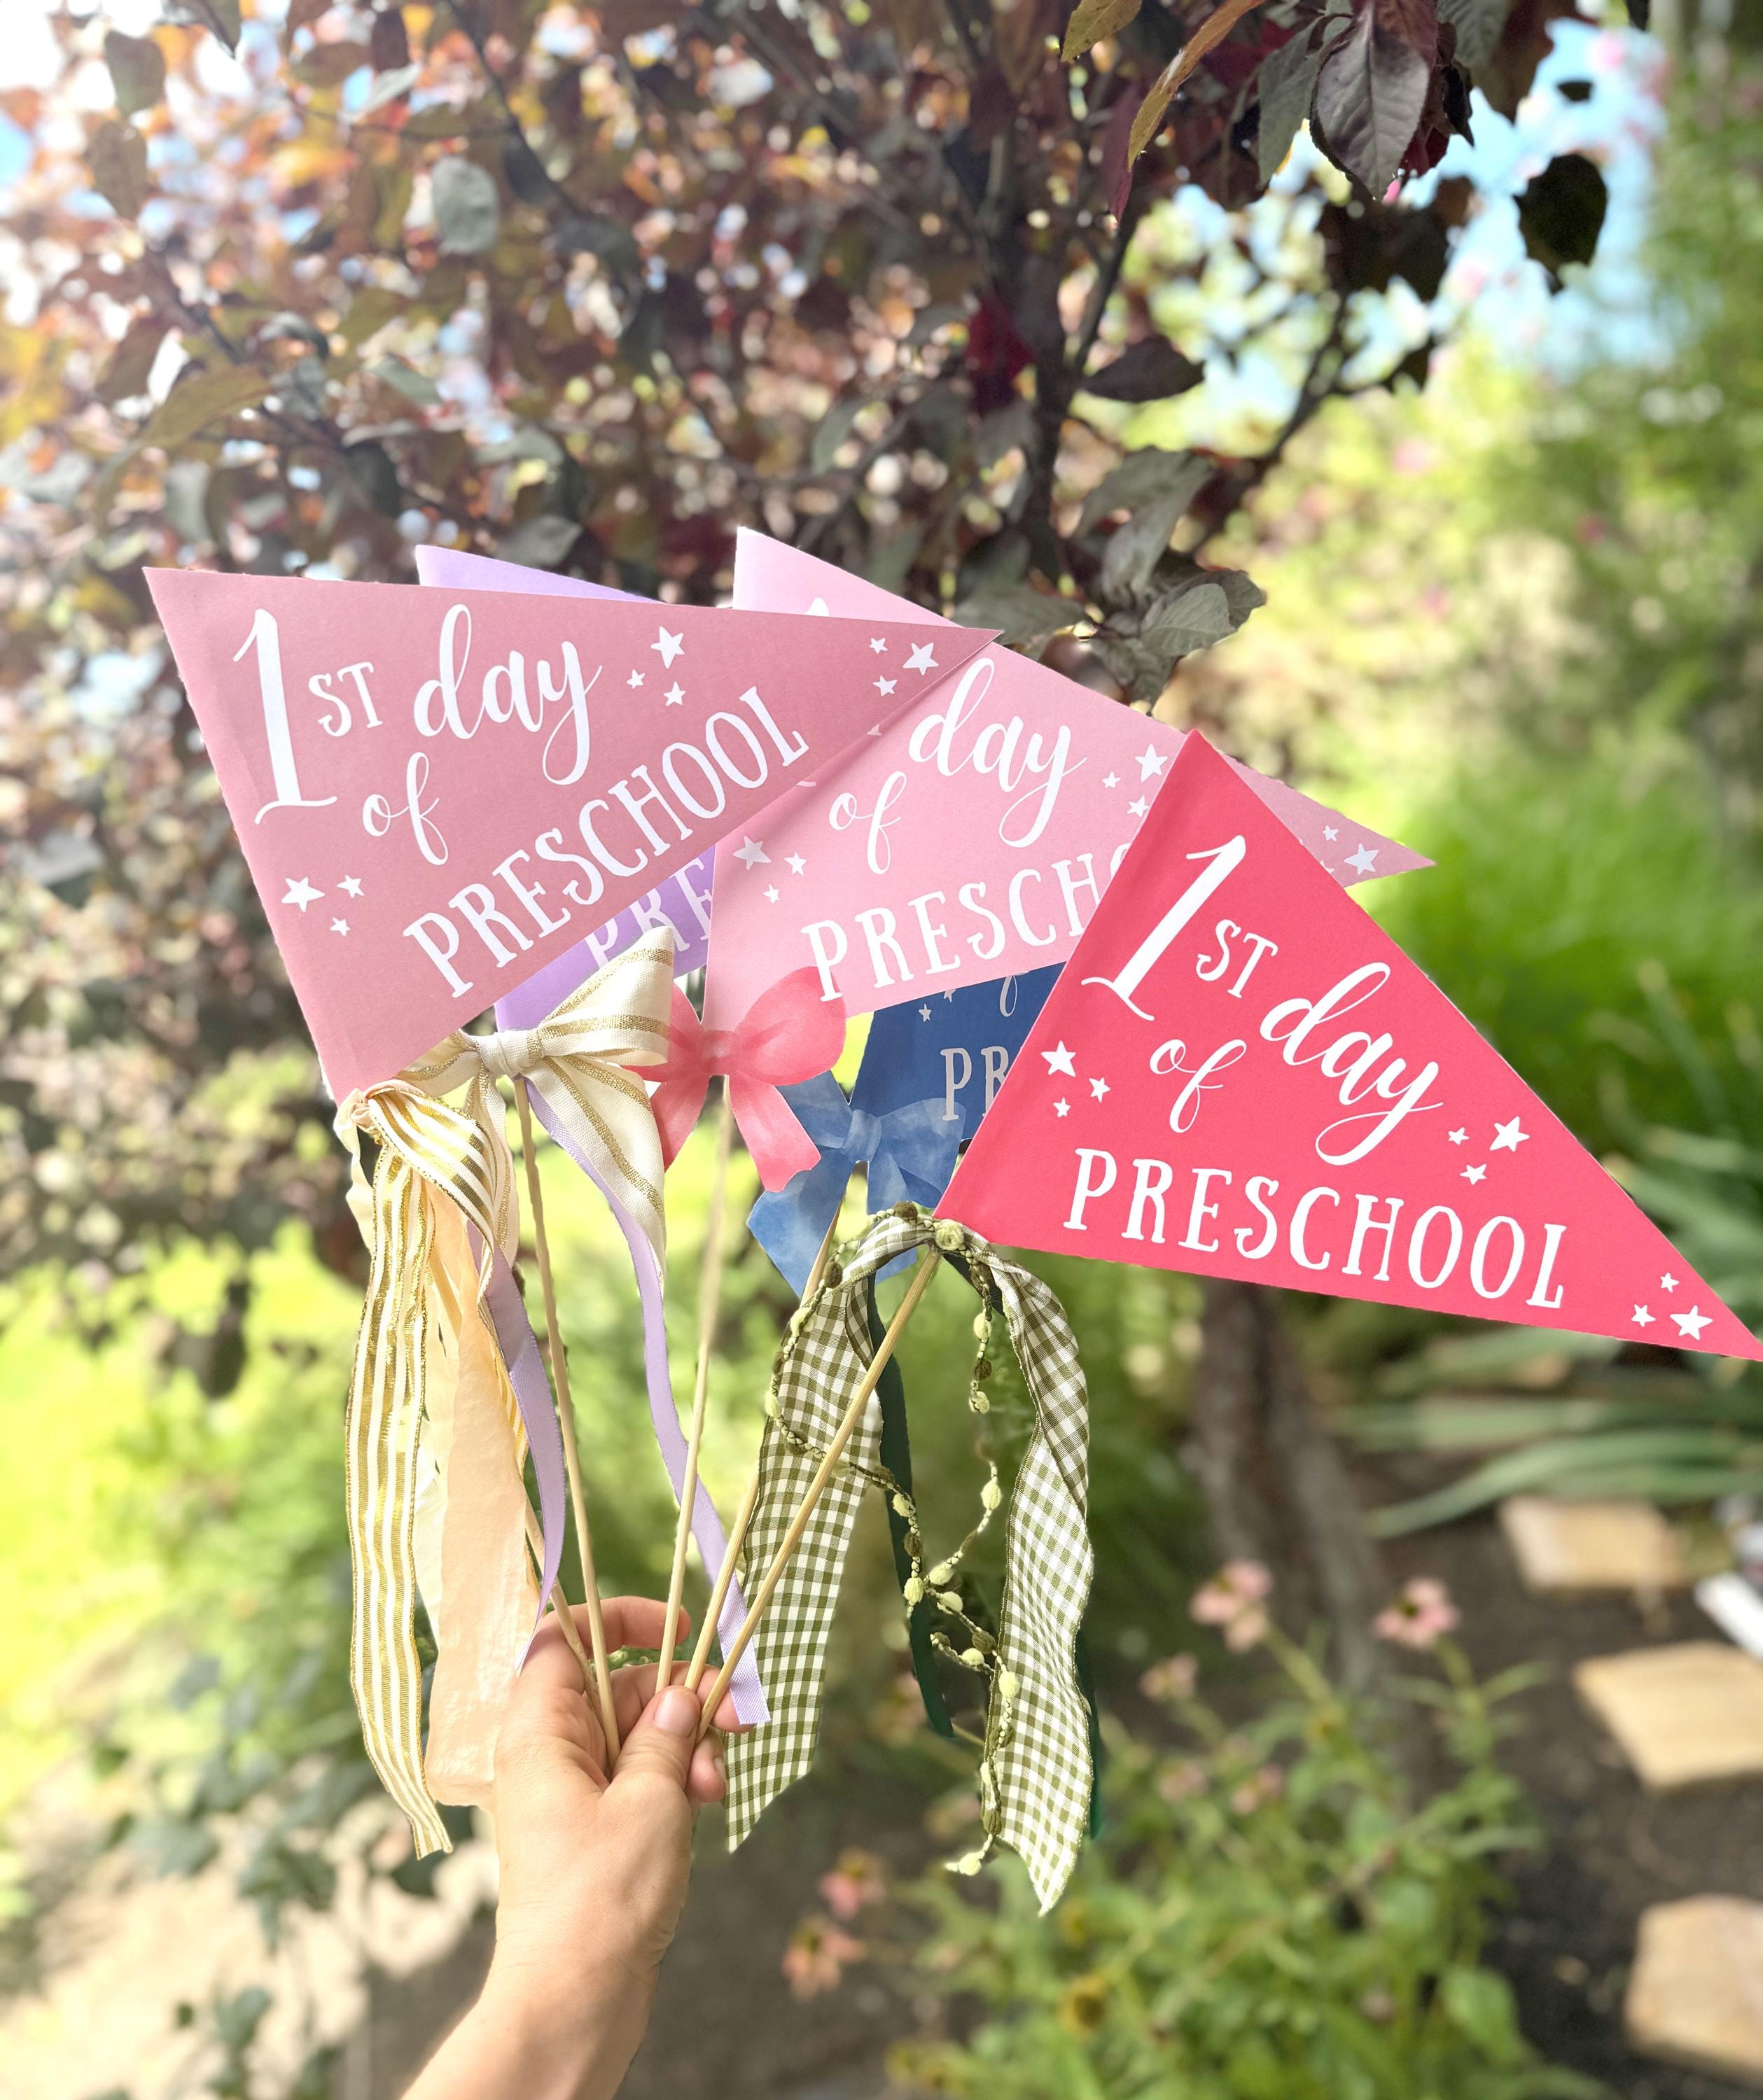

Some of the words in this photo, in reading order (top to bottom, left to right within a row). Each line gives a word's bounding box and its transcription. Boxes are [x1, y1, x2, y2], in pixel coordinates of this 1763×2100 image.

[232, 608, 384, 825] 1ST
[413, 603, 603, 786] day
[908, 657, 1087, 848] day
[361, 752, 449, 867] of
[403, 686, 809, 998] PRESCHOOL
[828, 771, 902, 875] of
[1081, 835, 1278, 1021] 1ST
[1260, 962, 1444, 1166] day
[1149, 1039, 1246, 1133] of
[1064, 1147, 1567, 1309] PRESCHOOL
